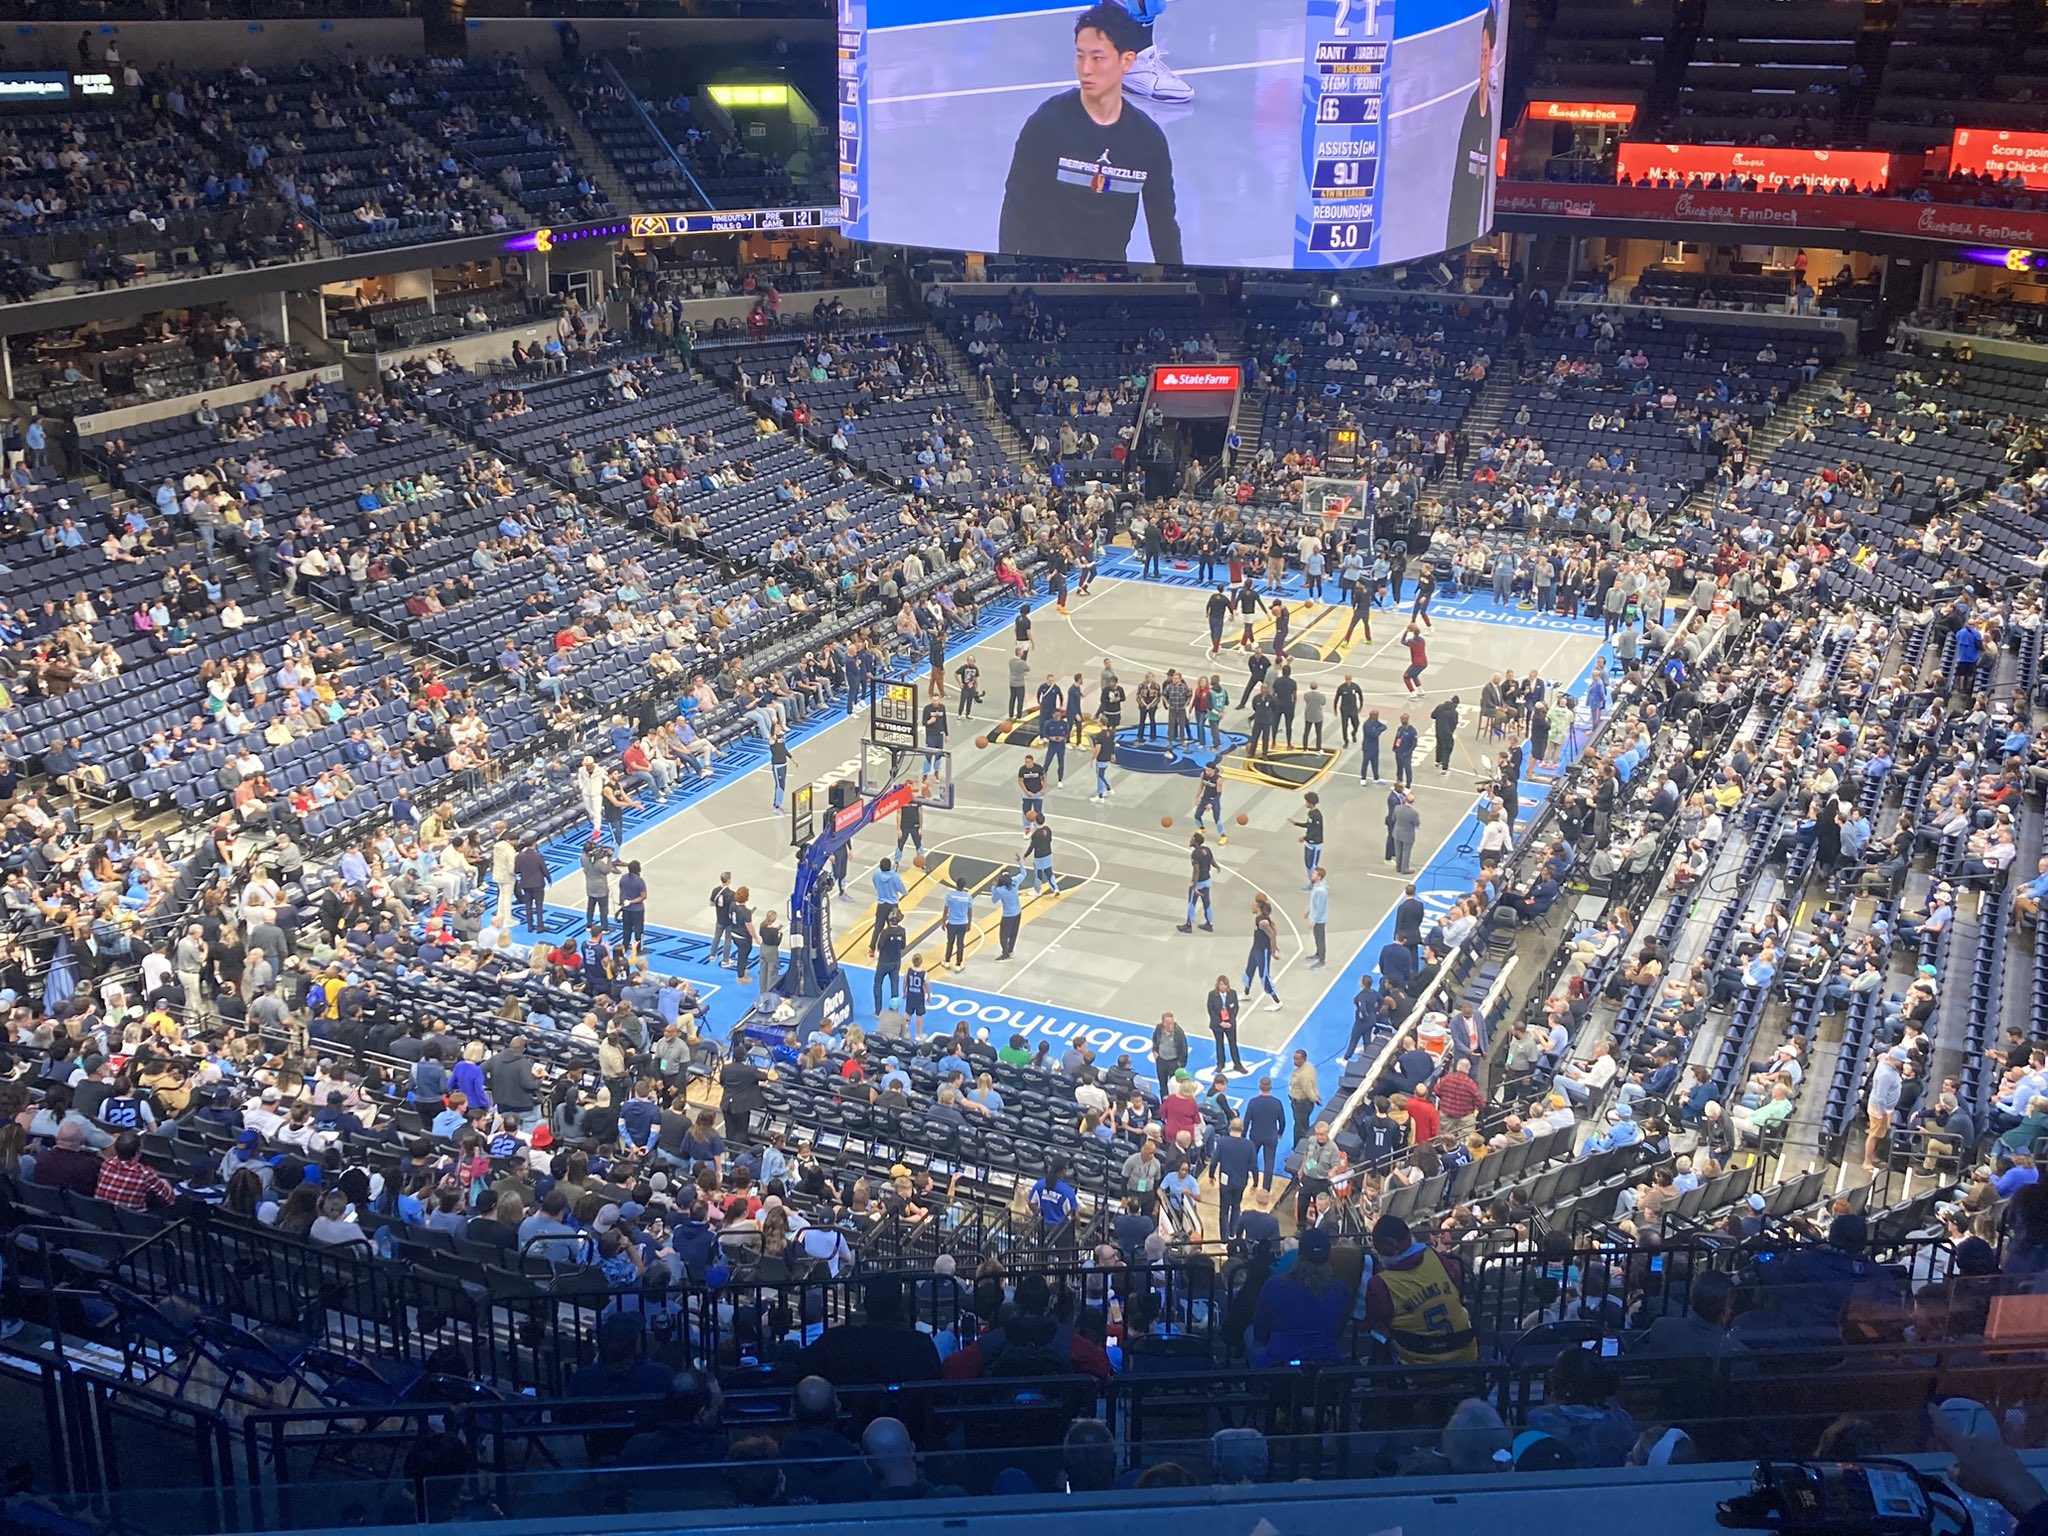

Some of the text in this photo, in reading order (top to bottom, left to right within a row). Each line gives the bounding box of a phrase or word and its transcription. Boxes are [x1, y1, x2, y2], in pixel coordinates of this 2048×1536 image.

[1319, 139, 1376, 157] ASSISTS/GM
[1992, 144, 2023, 156] Score
[1058, 157, 1148, 180] MEMPHIS GRIZZLIES
[1986, 160, 2004, 171] the
[1313, 203, 1373, 220] REBOUNDS/GM
[1541, 198, 1596, 212] FanDeck
[765, 212, 780, 221] PRE
[793, 211, 812, 226] 1:21
[1740, 207, 1799, 223] FanDeck
[675, 217, 688, 232] 0
[762, 219, 784, 228] GAME
[1330, 224, 1358, 248] 5.0
[1978, 224, 2034, 240] FanDeck
[909, 975, 921, 987] 10
[110, 1108, 136, 1127] 22
[490, 1138, 515, 1155] 22
[1375, 1132, 1384, 1146] 11
[1402, 1282, 1441, 1313] WILLIAMS
